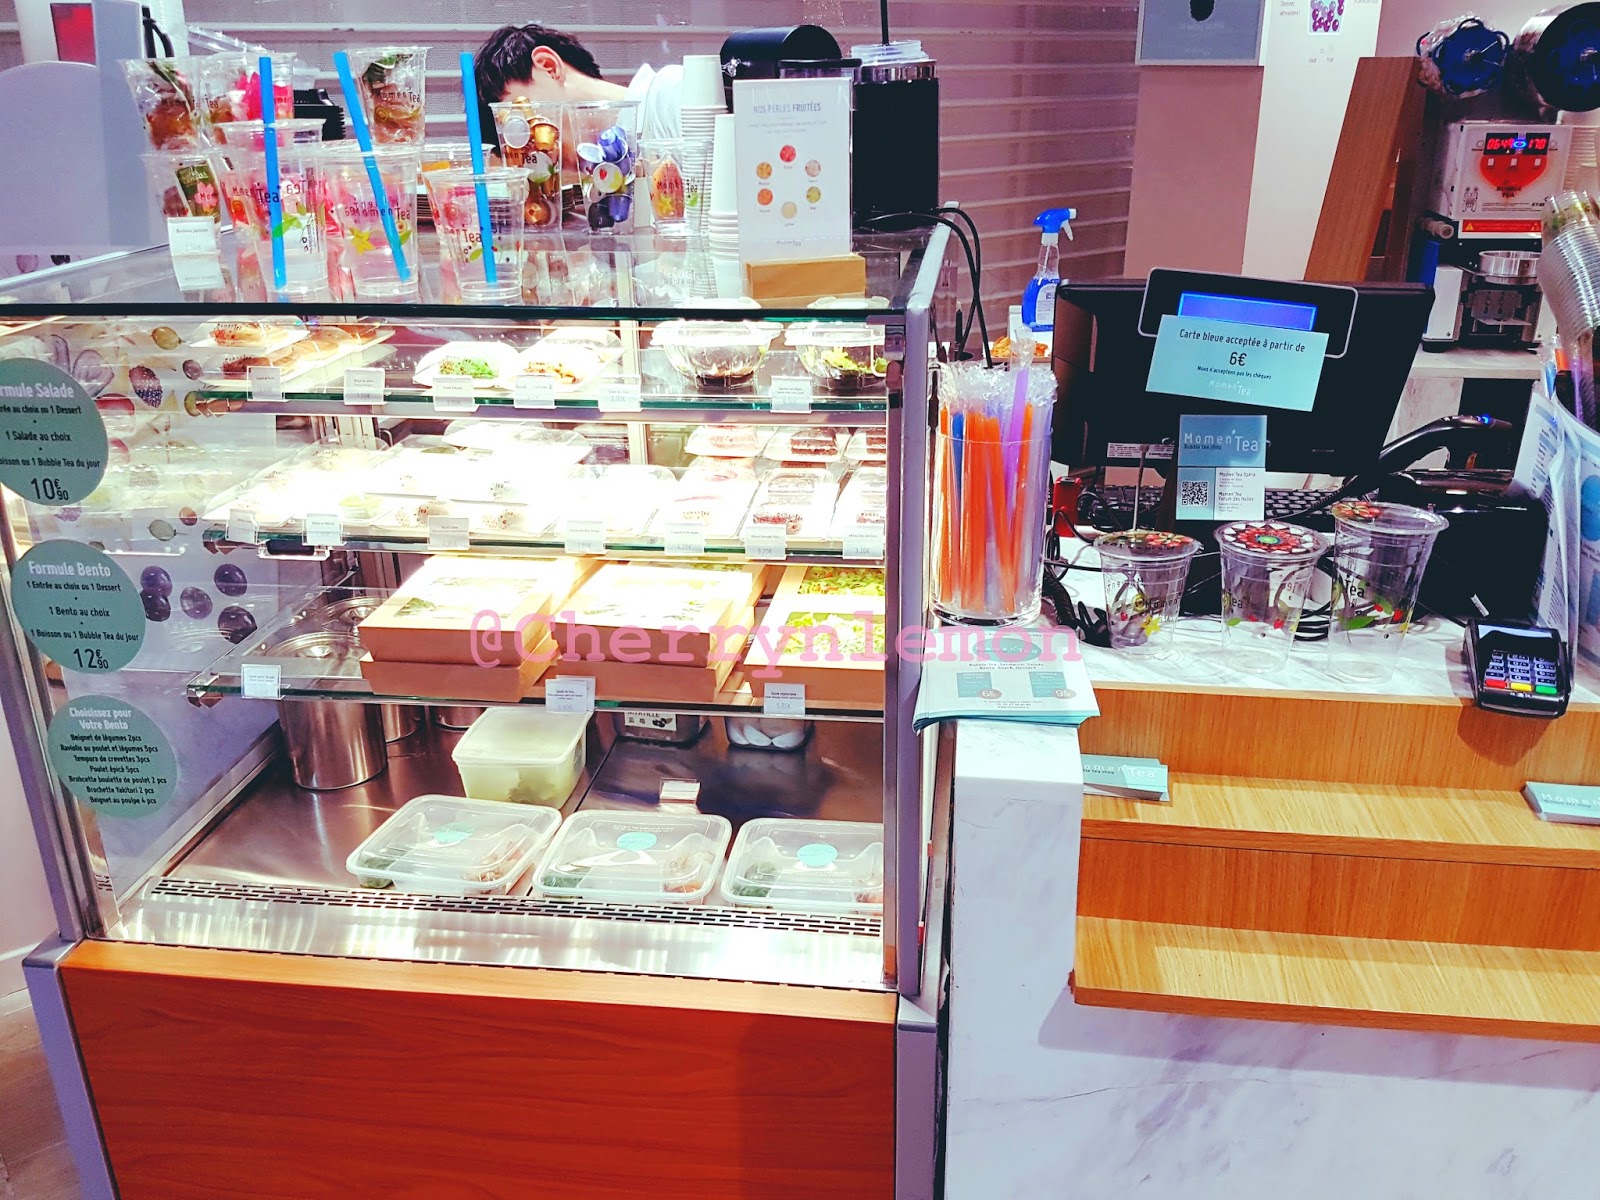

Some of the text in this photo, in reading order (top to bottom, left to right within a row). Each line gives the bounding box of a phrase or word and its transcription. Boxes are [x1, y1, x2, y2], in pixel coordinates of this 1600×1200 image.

[793, 100, 822, 112] FRUITÉES
[1179, 329, 1306, 352] Carte bleue acceptée à partir de
[1229, 351, 1248, 367] 6€
[35, 382, 74, 398] Salade
[22, 405, 39, 414] choix
[50, 406, 54, 414] 1
[56, 406, 82, 414] Dessert
[6, 431, 10, 440] 1
[12, 431, 38, 441] Salade
[50, 432, 72, 441] choix
[31, 458, 36, 466] 1
[38, 458, 62, 466] Bubble
[62, 458, 74, 467] Tea
[76, 459, 85, 467] du
[86, 459, 100, 469] jour
[28, 561, 111, 577] Formule Bento
[32, 581, 53, 590] Entrée
[64, 582, 80, 590] choix
[96, 583, 122, 592] Dessert
[49, 606, 110, 617] 1 Bento au choix
[36, 630, 62, 638] Boisson
[79, 631, 102, 640] Bubble
[103, 632, 114, 640] Tea
[116, 633, 124, 641] du
[125, 634, 139, 642] jour
[69, 708, 132, 719] Choisissez pour
[79, 720, 129, 730] Votre Bento
[70, 734, 93, 742] Beignet
[102, 734, 127, 743] légumes
[128, 734, 142, 743] 2pcs
[60, 744, 83, 752] Raviolis
[92, 745, 110, 753] poulet
[119, 745, 143, 753] légumes
[144, 745, 158, 753] 5pcs
[108, 755, 136, 763] crevettes
[89, 765, 109, 773] Poulet
[125, 766, 140, 774] 5pcs
[131, 776, 151, 785] poulet
[115, 786, 138, 794] Yakitori
[89, 796, 112, 805] Beignet
[121, 797, 140, 805] poulpe
